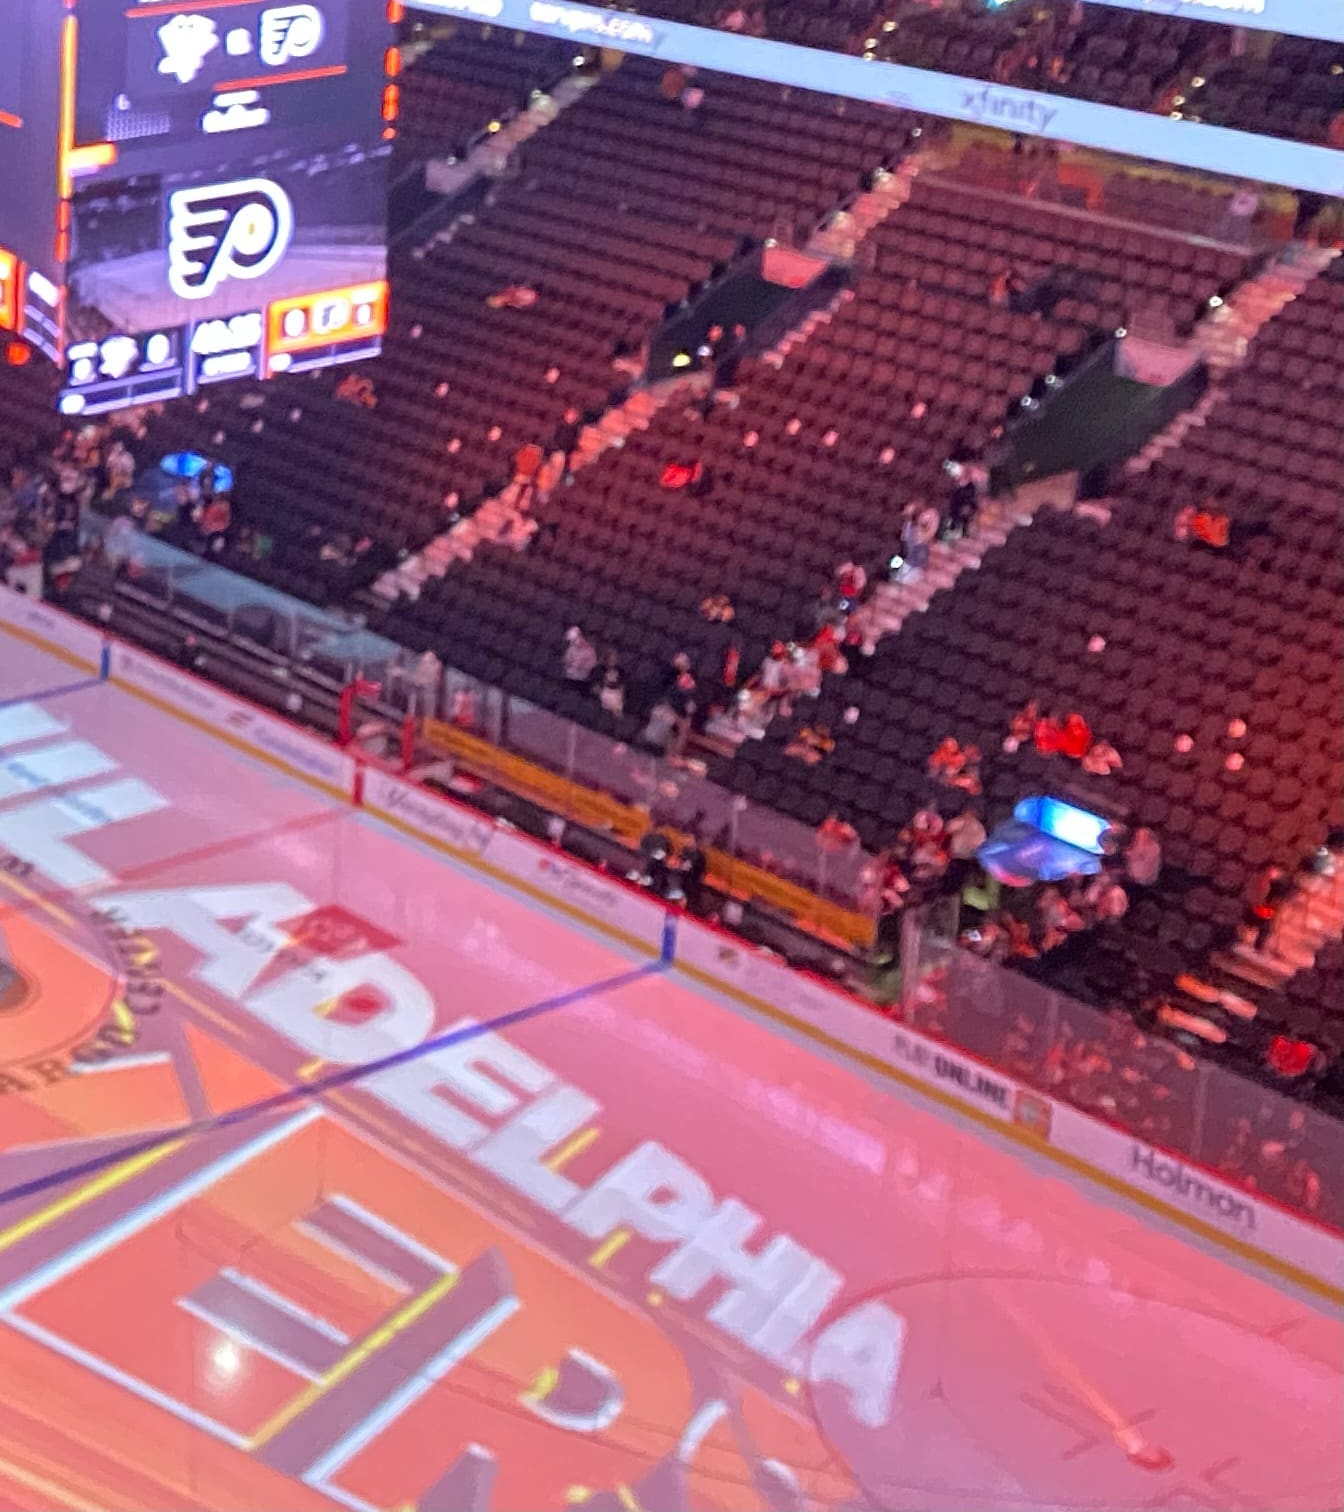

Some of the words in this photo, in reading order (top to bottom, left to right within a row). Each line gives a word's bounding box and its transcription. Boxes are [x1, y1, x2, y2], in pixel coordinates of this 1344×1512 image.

[960, 89, 1058, 132] xfinity
[932, 1052, 1011, 1110] ONLINE
[1130, 1143, 1257, 1230] Holman
